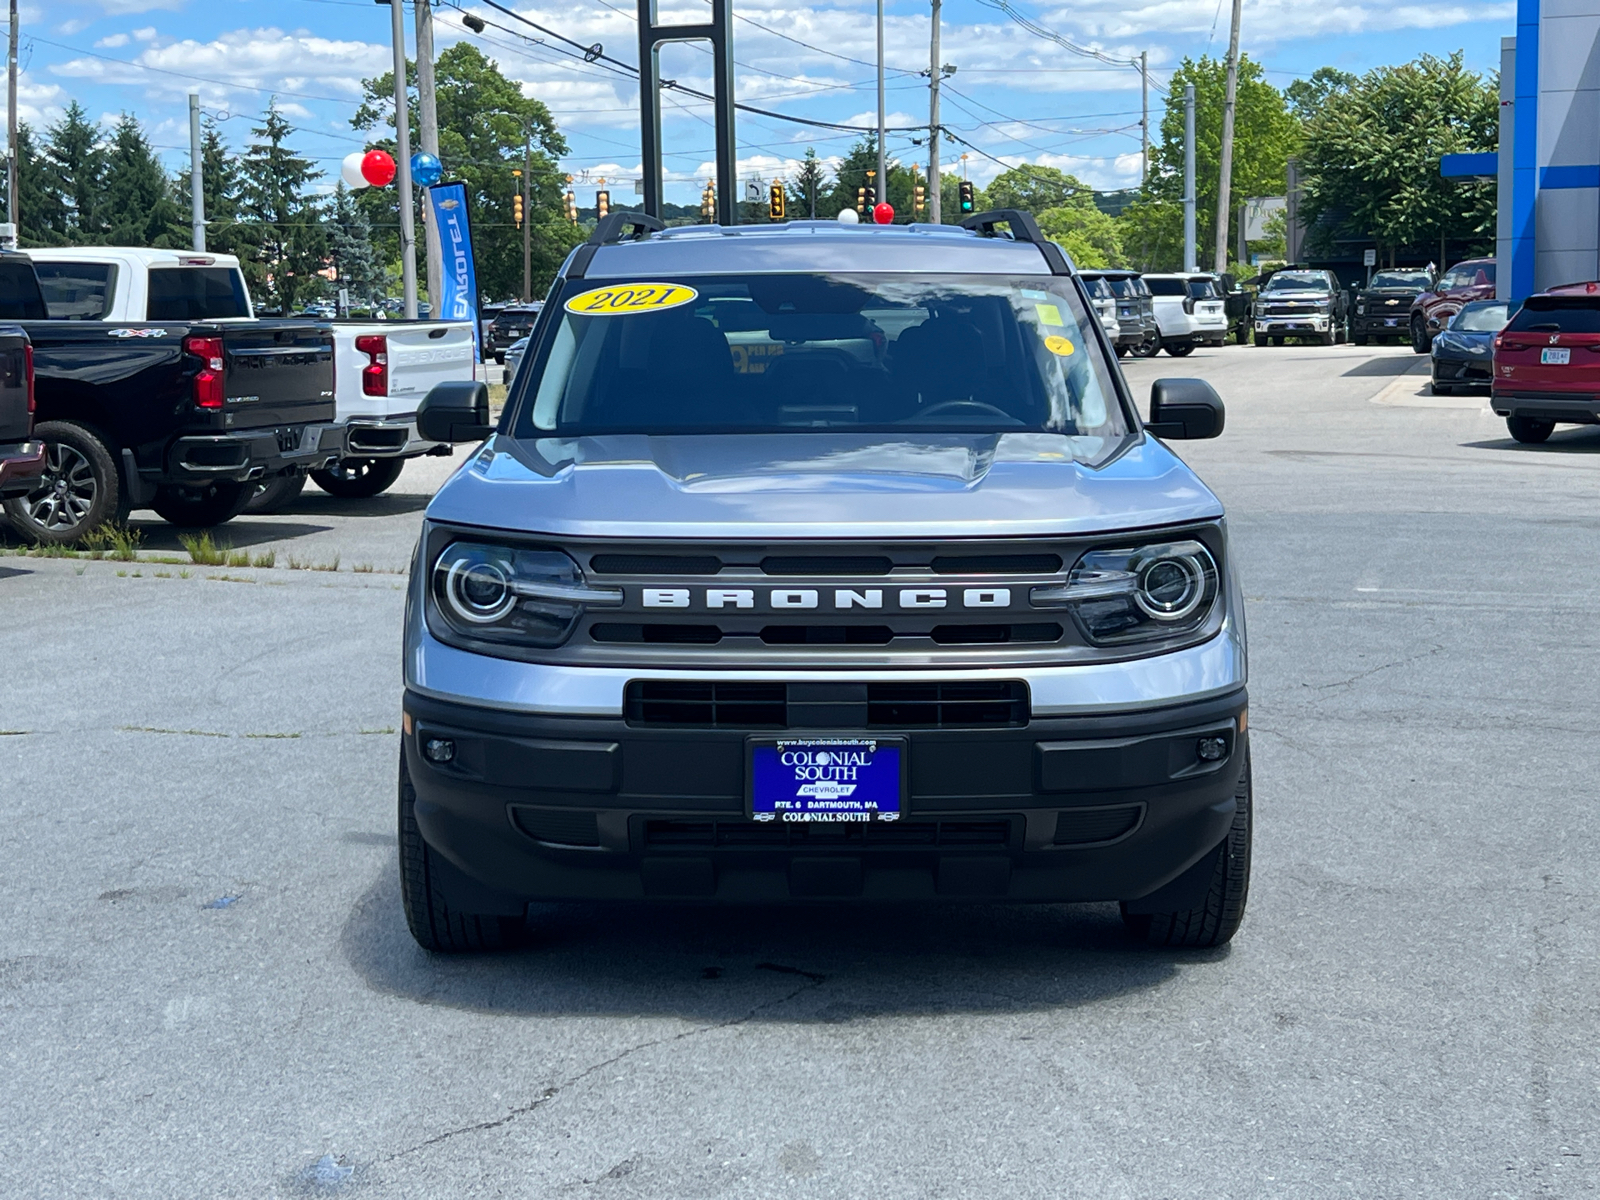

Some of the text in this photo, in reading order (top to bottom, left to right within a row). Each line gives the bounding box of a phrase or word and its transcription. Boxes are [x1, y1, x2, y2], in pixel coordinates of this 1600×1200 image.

[585, 288, 677, 310] 2021
[643, 588, 1011, 609] BRONCO
[776, 739, 877, 747] www.buycolonialsouth.com
[781, 751, 871, 766] COLONIAL
[795, 766, 857, 780] SOUTH
[775, 801, 878, 810] RTE. 6 DARTMOUTH, MA
[782, 812, 870, 822] COLONIAL SOUTH
